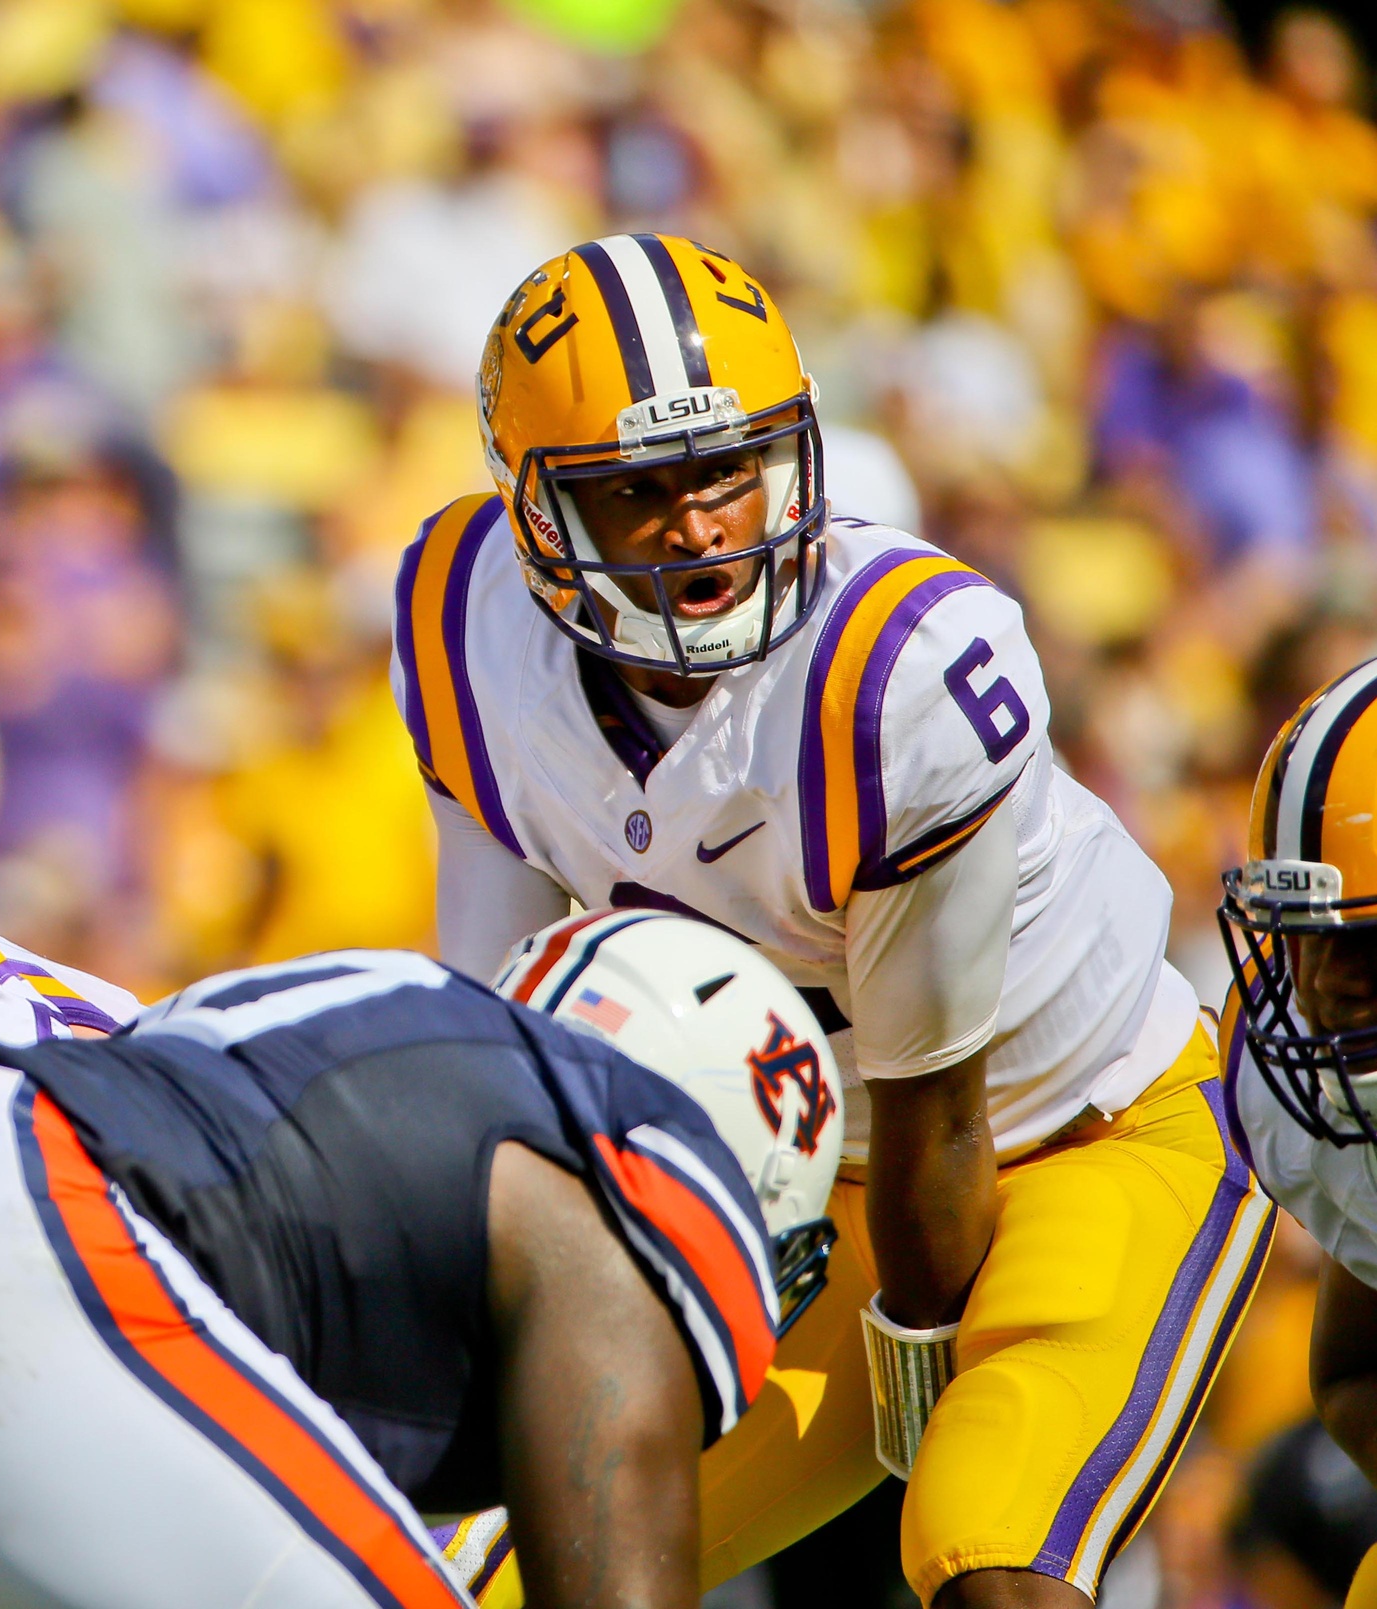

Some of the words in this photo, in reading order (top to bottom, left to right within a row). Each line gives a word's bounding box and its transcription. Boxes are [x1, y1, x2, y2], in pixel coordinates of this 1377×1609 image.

[649, 394, 711, 424] LSU
[685, 639, 730, 654] Riddell
[943, 636, 1030, 765] 6
[1265, 869, 1311, 891] LSU
